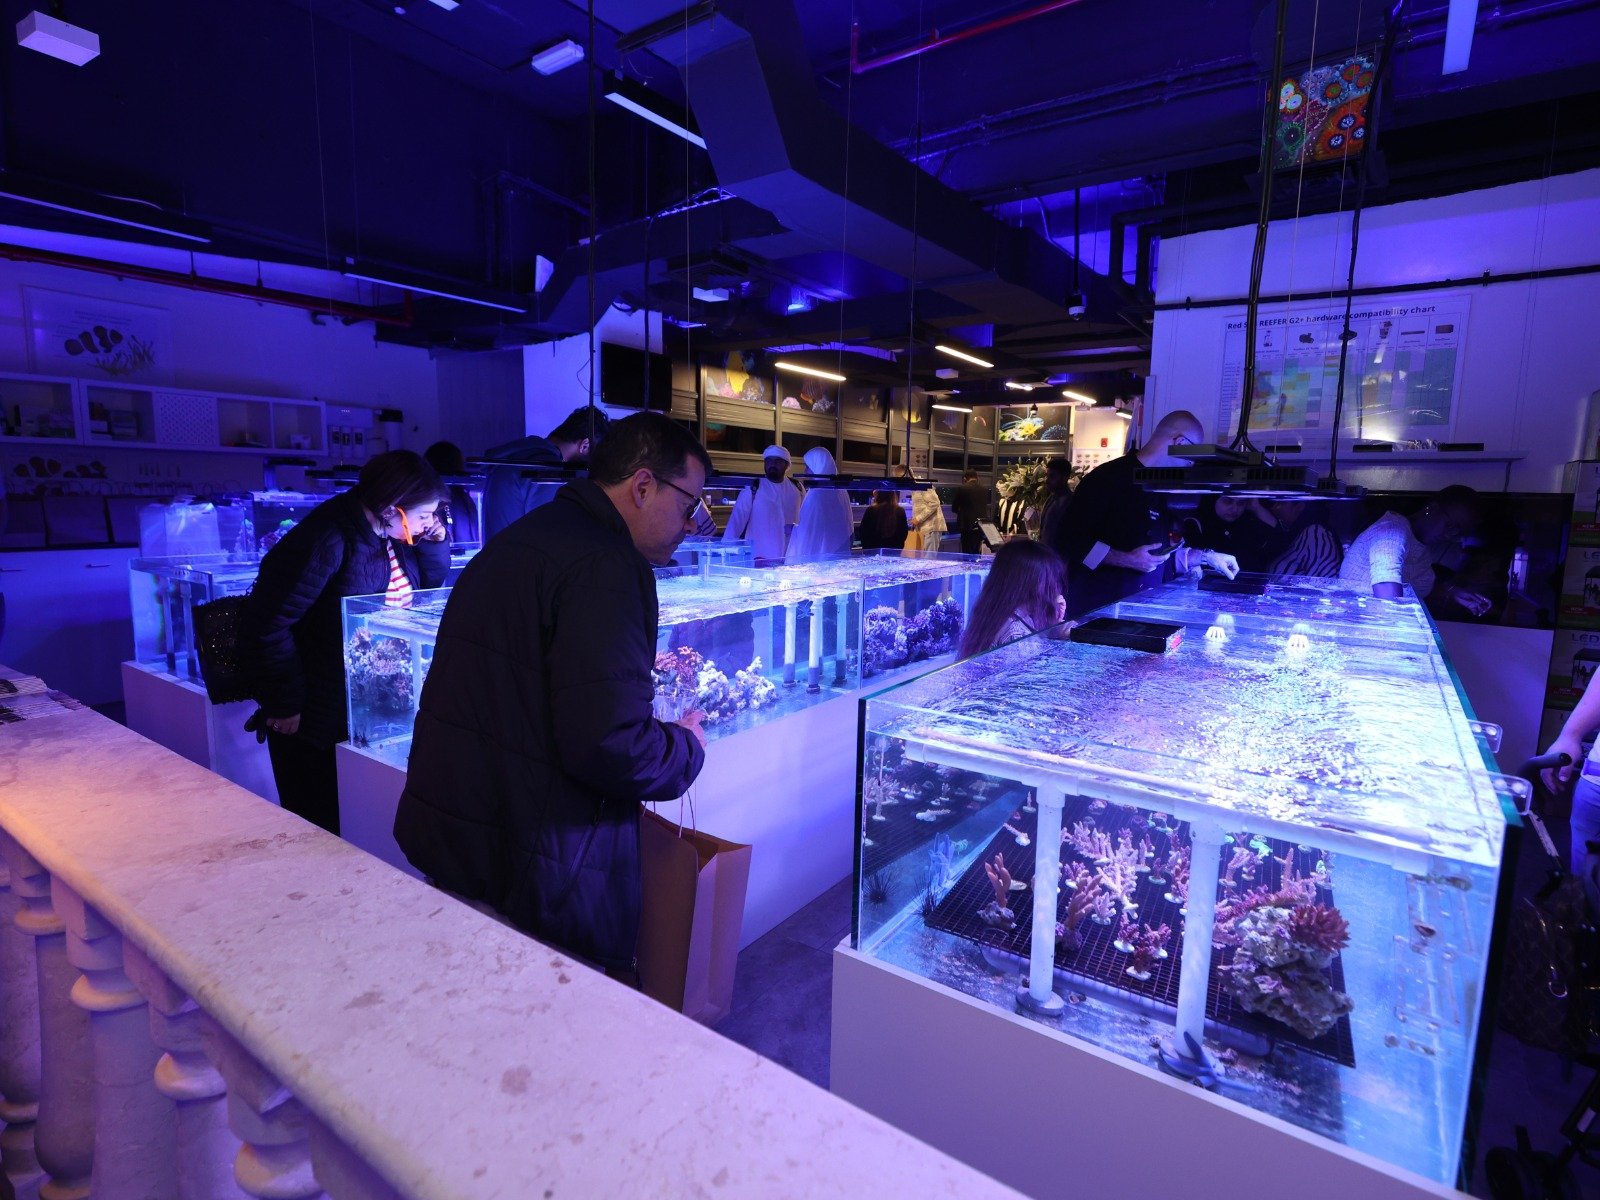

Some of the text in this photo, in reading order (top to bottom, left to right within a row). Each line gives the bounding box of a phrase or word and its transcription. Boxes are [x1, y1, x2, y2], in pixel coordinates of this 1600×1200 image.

[1228, 322, 1242, 330] Red
[1259, 317, 1288, 327] REEFER
[1306, 313, 1347, 324] hardware
[1349, 307, 1409, 320] compatibility
[1411, 305, 1436, 314] chart
